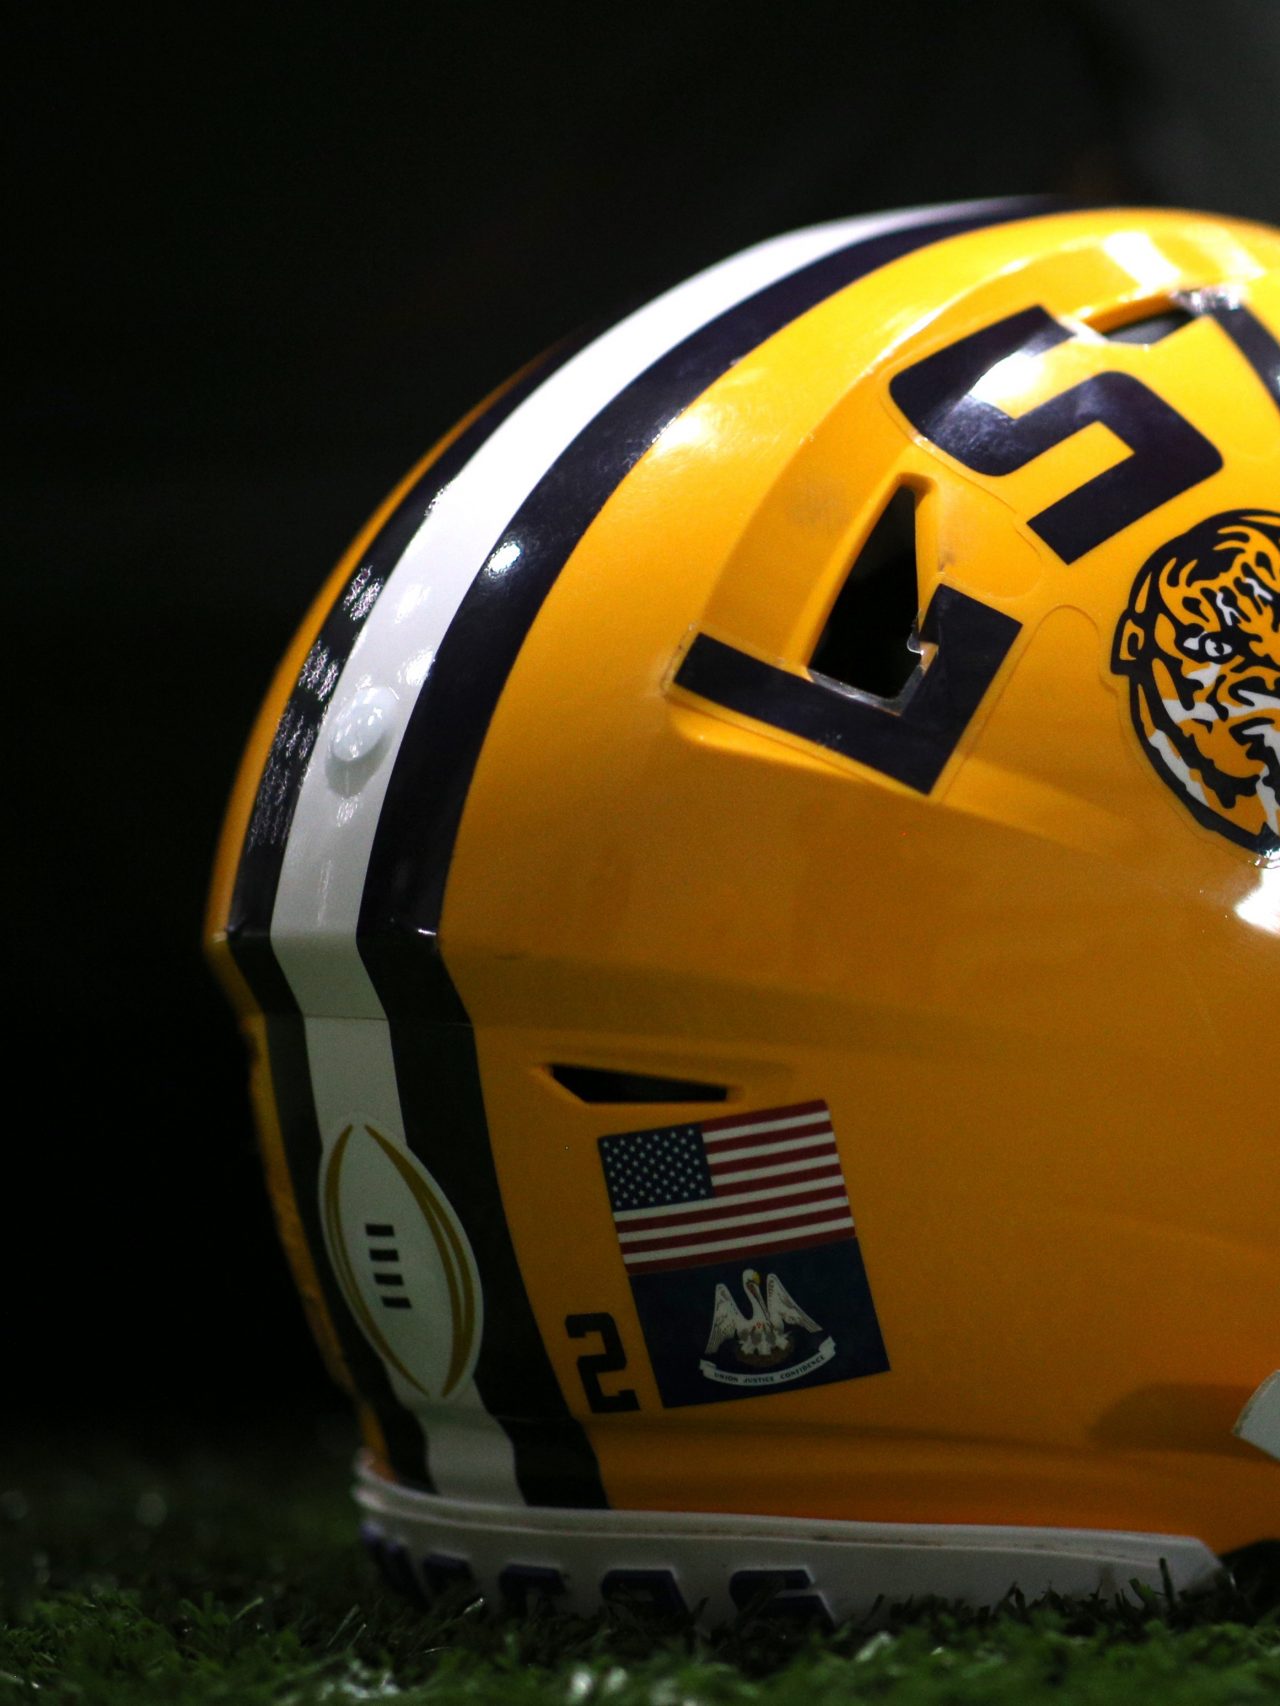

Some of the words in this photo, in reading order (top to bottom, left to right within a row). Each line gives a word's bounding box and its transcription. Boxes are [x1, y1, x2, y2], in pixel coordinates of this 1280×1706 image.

[565, 1312, 640, 1414] 2
[714, 1371, 738, 1382] UNION
[743, 1375, 774, 1384] JUSTICE
[780, 1355, 825, 1380] CONFIDENCE
